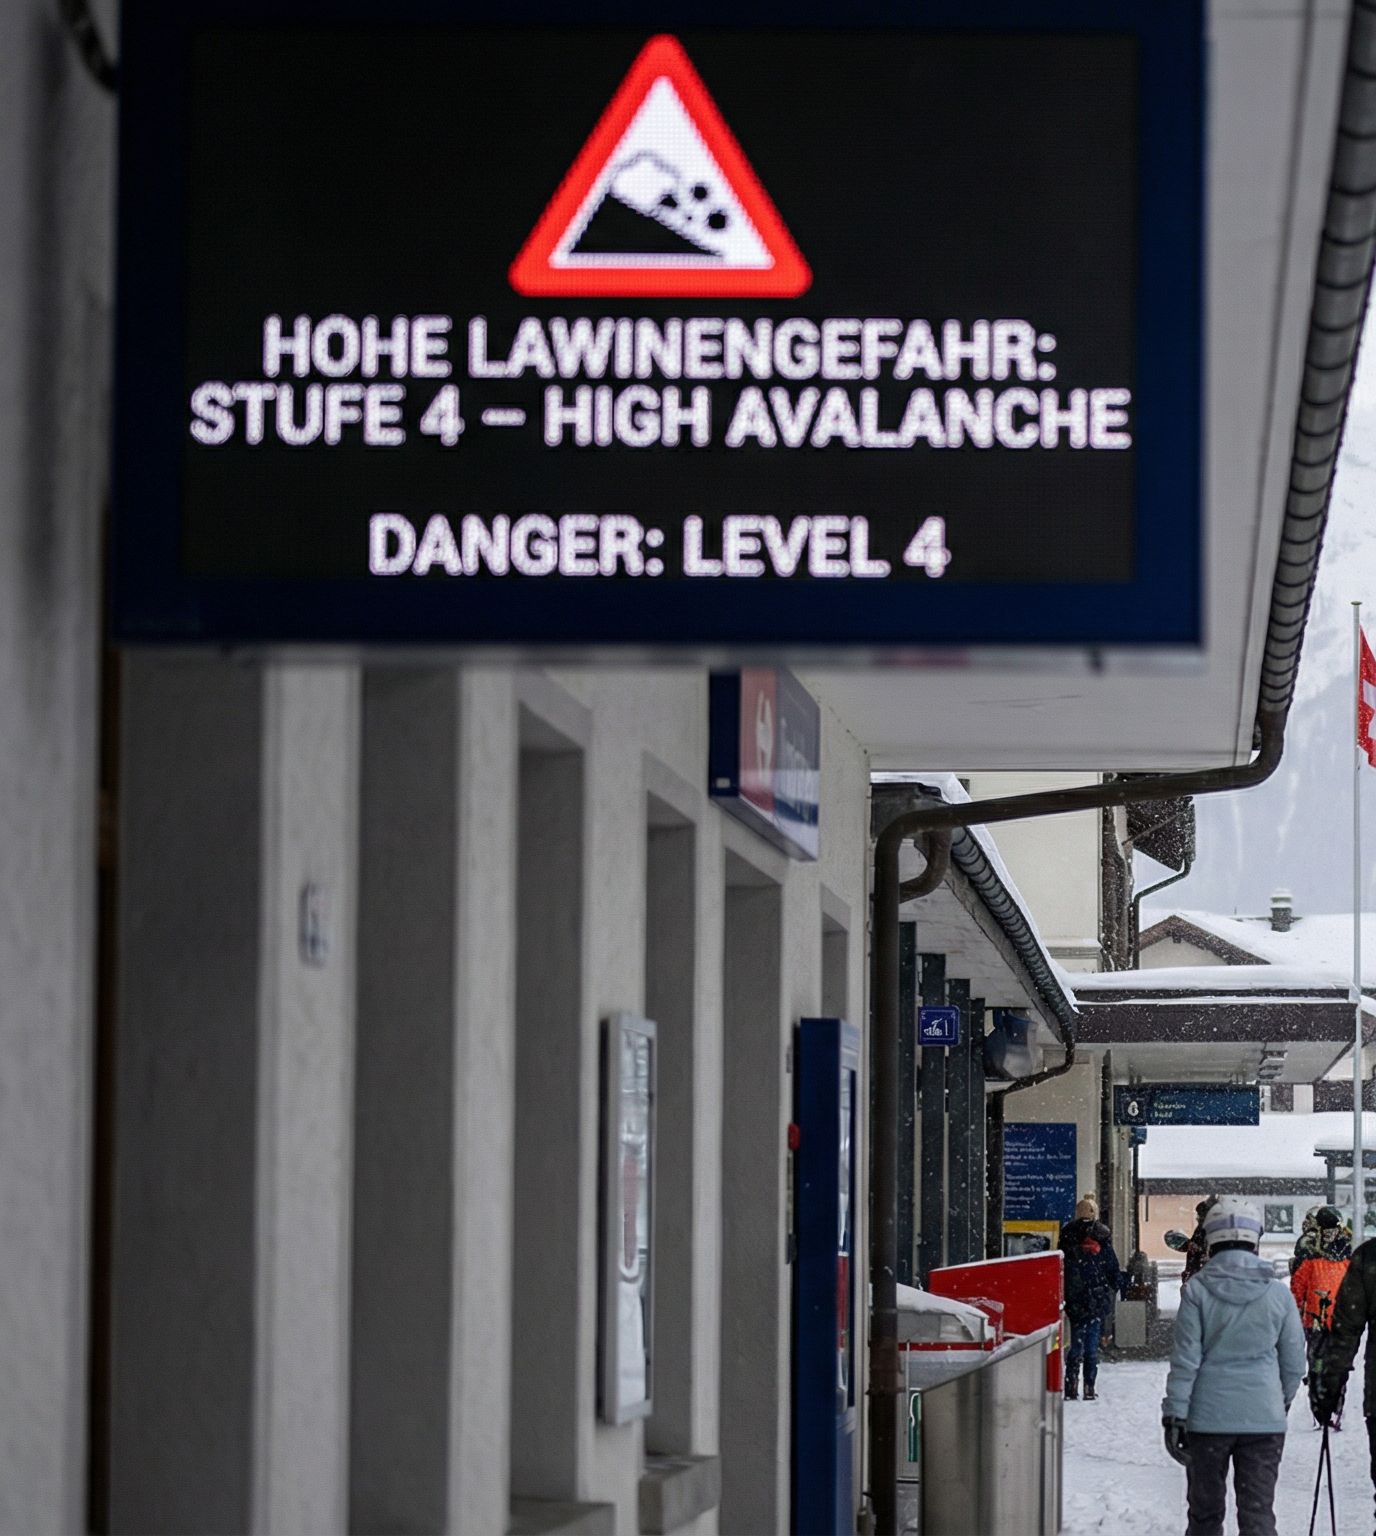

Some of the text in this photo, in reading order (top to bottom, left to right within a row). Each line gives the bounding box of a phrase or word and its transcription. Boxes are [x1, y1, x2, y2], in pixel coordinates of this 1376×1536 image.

[263, 316, 1057, 381] HOHE LAWINENGEFAHR:
[190, 383, 404, 445] STUFE
[420, 386, 464, 445] 4
[544, 387, 710, 446] HIGH
[726, 388, 1132, 449] AVALANCHE
[369, 514, 951, 577] DANGER: LEVEL 4
